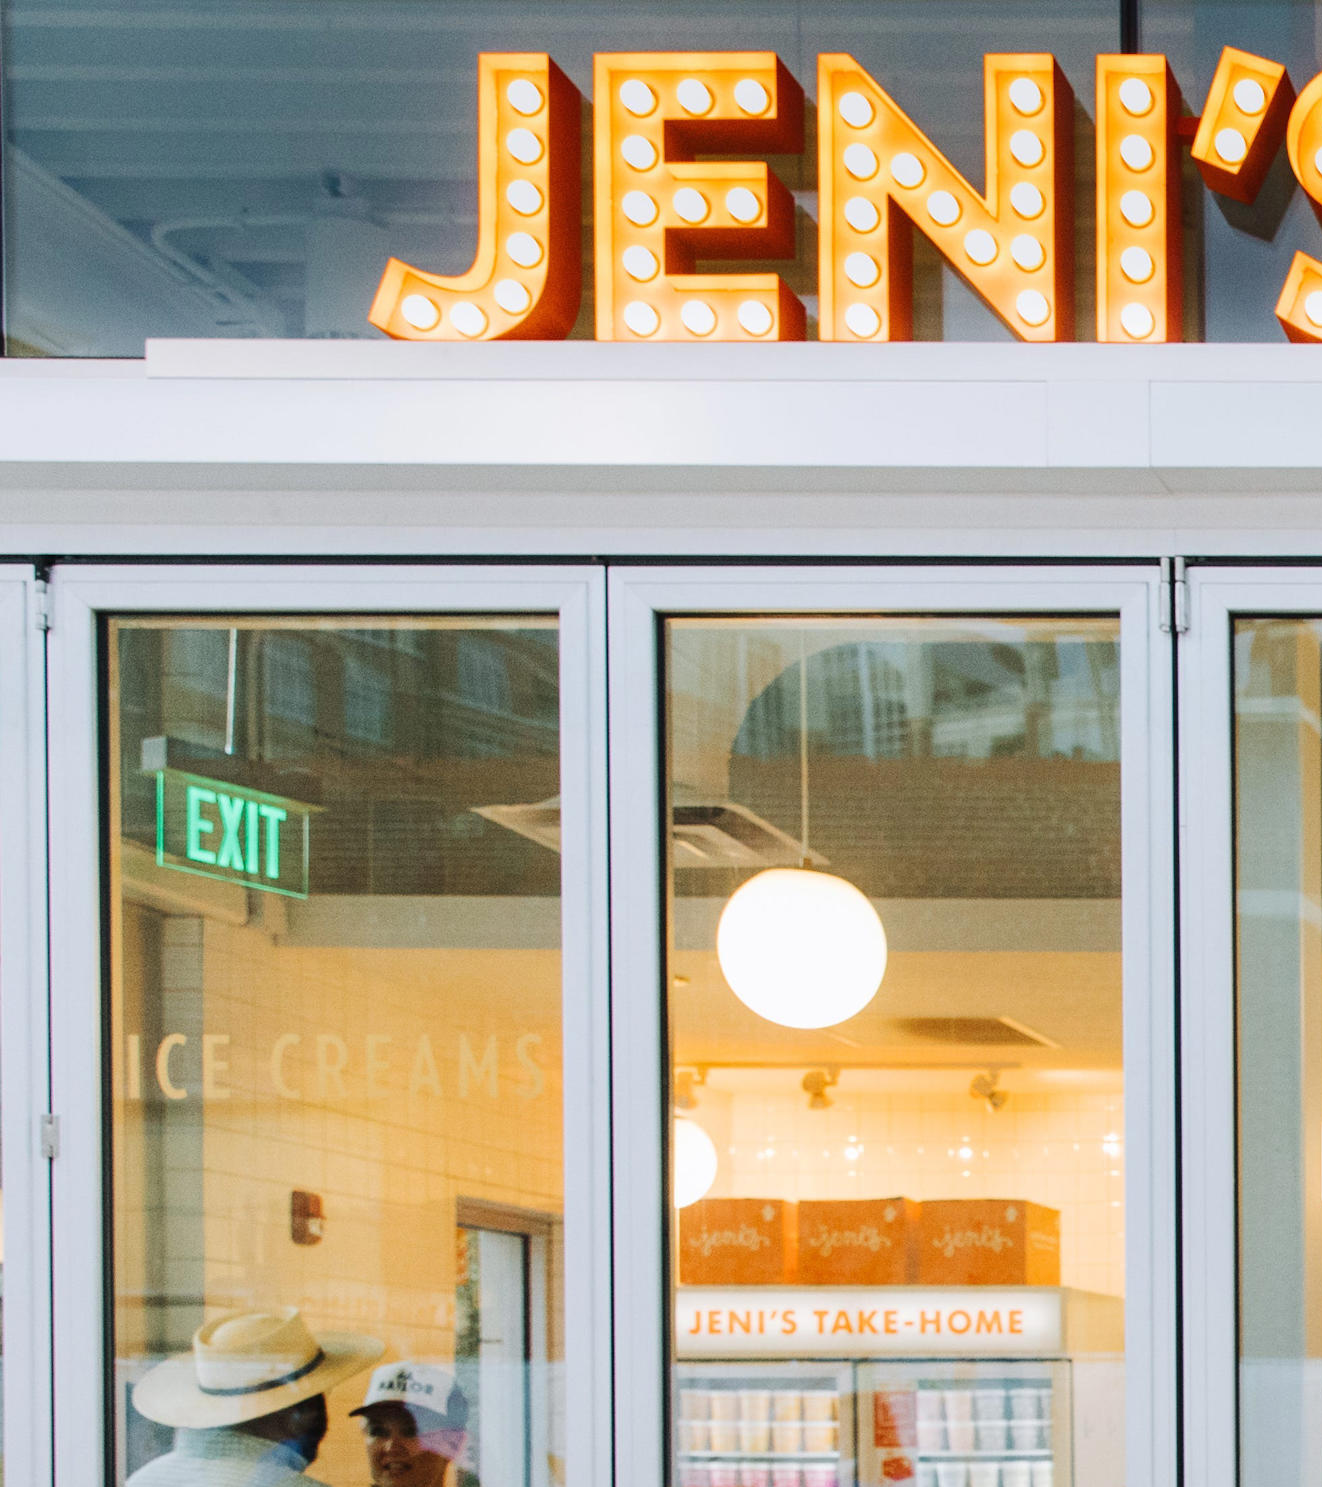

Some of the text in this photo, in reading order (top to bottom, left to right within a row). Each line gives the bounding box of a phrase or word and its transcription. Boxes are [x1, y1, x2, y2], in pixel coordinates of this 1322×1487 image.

[186, 785, 287, 880] EXIT
[127, 1033, 545, 1100] ICE CREAMS
[689, 1309, 1025, 1337] JENI'S TAKE-HOME
